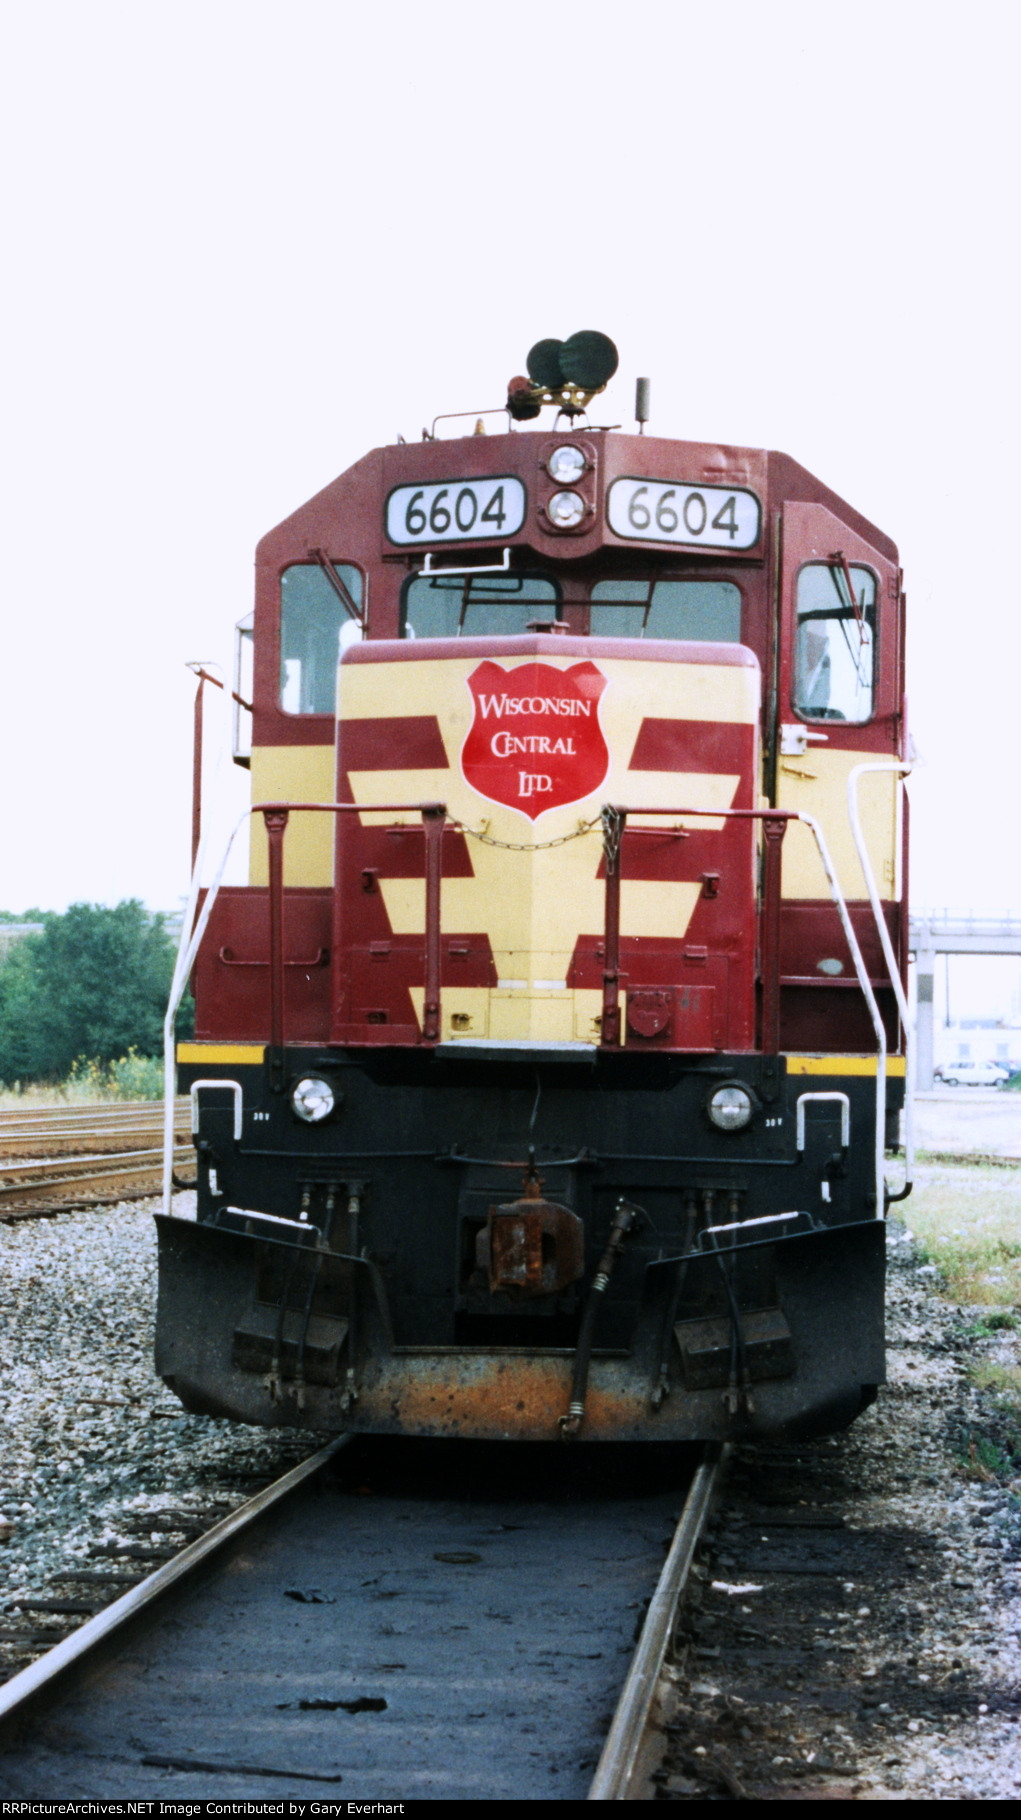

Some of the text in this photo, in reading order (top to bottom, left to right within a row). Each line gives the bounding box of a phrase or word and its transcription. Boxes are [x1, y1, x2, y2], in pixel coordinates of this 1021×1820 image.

[405, 485, 507, 535] 6604
[627, 486, 739, 540] 6604
[477, 693, 592, 719] WISCONSIN
[490, 731, 577, 757] CENTRAL
[517, 771, 553, 797] LTD.
